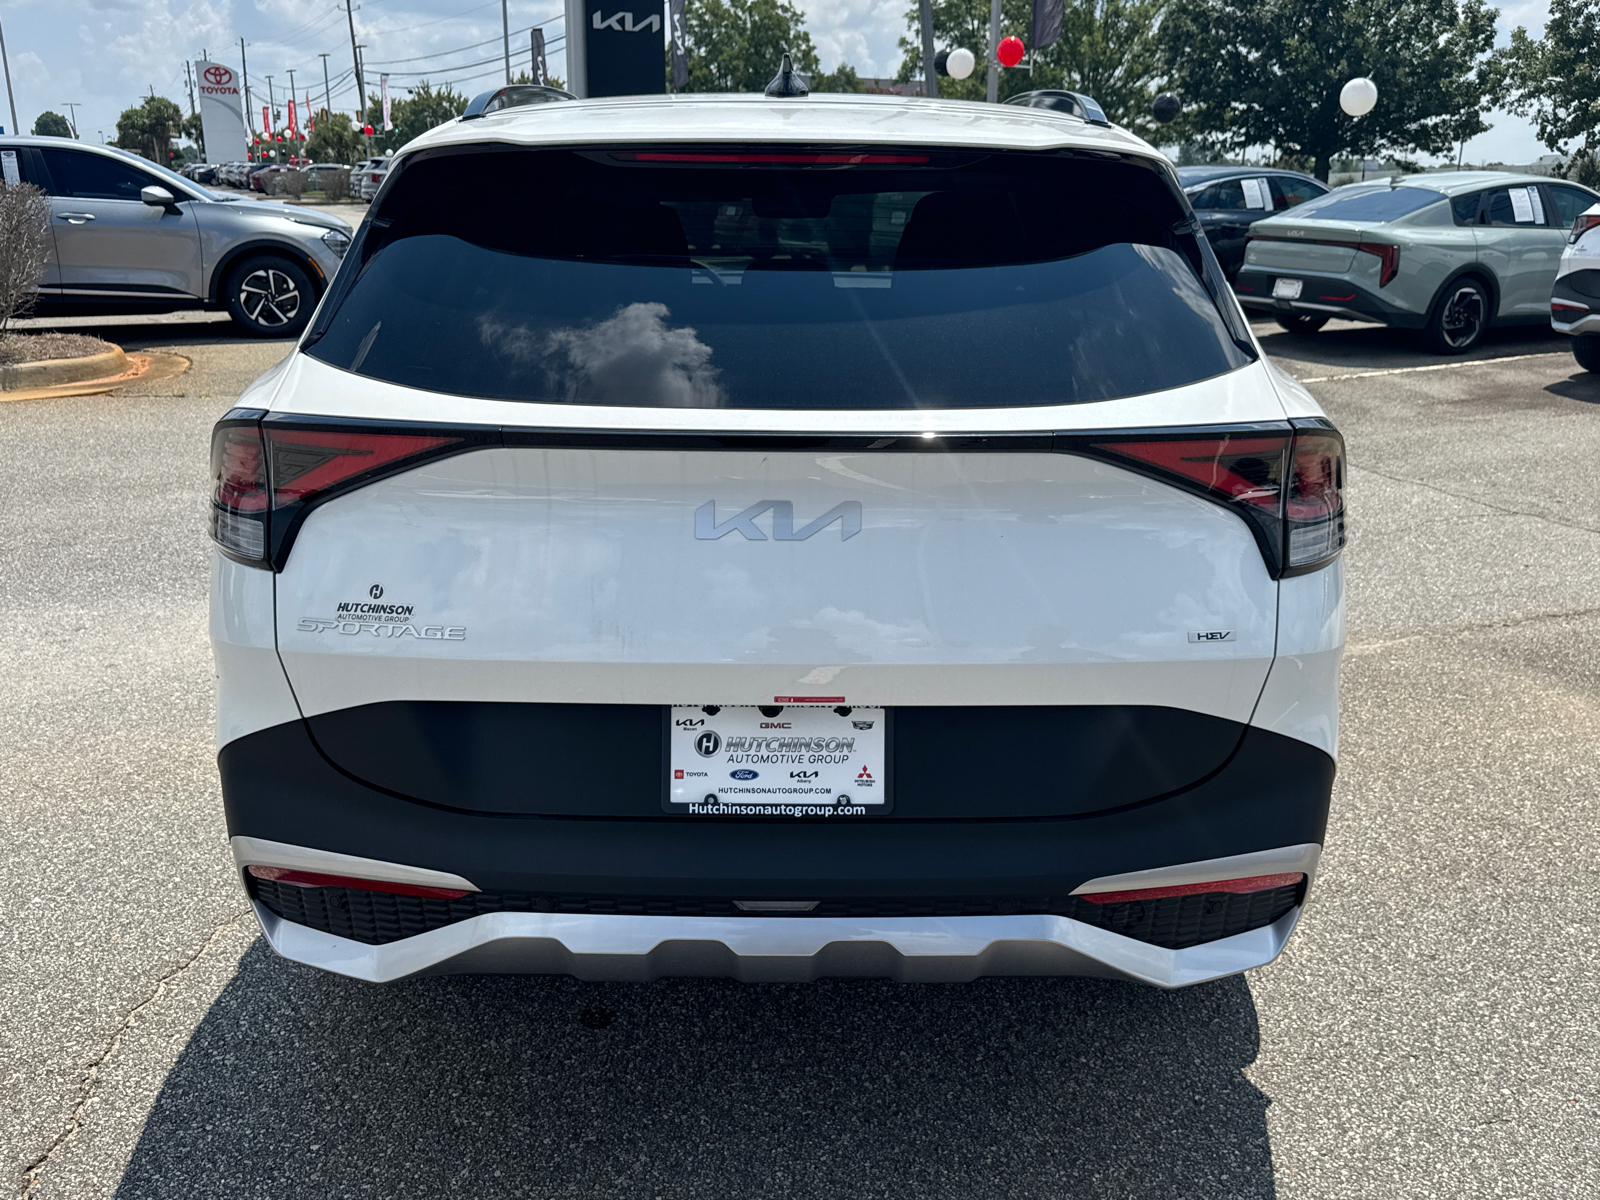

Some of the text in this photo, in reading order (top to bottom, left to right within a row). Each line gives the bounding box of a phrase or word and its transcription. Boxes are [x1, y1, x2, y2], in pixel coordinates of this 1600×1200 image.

[592, 10, 661, 33] KIA
[200, 86, 239, 95] TOYOTA
[695, 499, 862, 541] KIA
[337, 602, 414, 616] HUTCHINSON
[337, 613, 383, 622] AUTOMOTIVE
[297, 617, 466, 641] SPORTAGE
[1197, 631, 1231, 640] HEV
[675, 718, 705, 726] KIA
[725, 736, 856, 753] HUTCHINSON
[726, 754, 849, 764] AUTOMOTIVE GROUP
[734, 770, 755, 779] Ford
[789, 770, 819, 778] KIA
[689, 803, 866, 817] Hutchinsonautogroup.com
